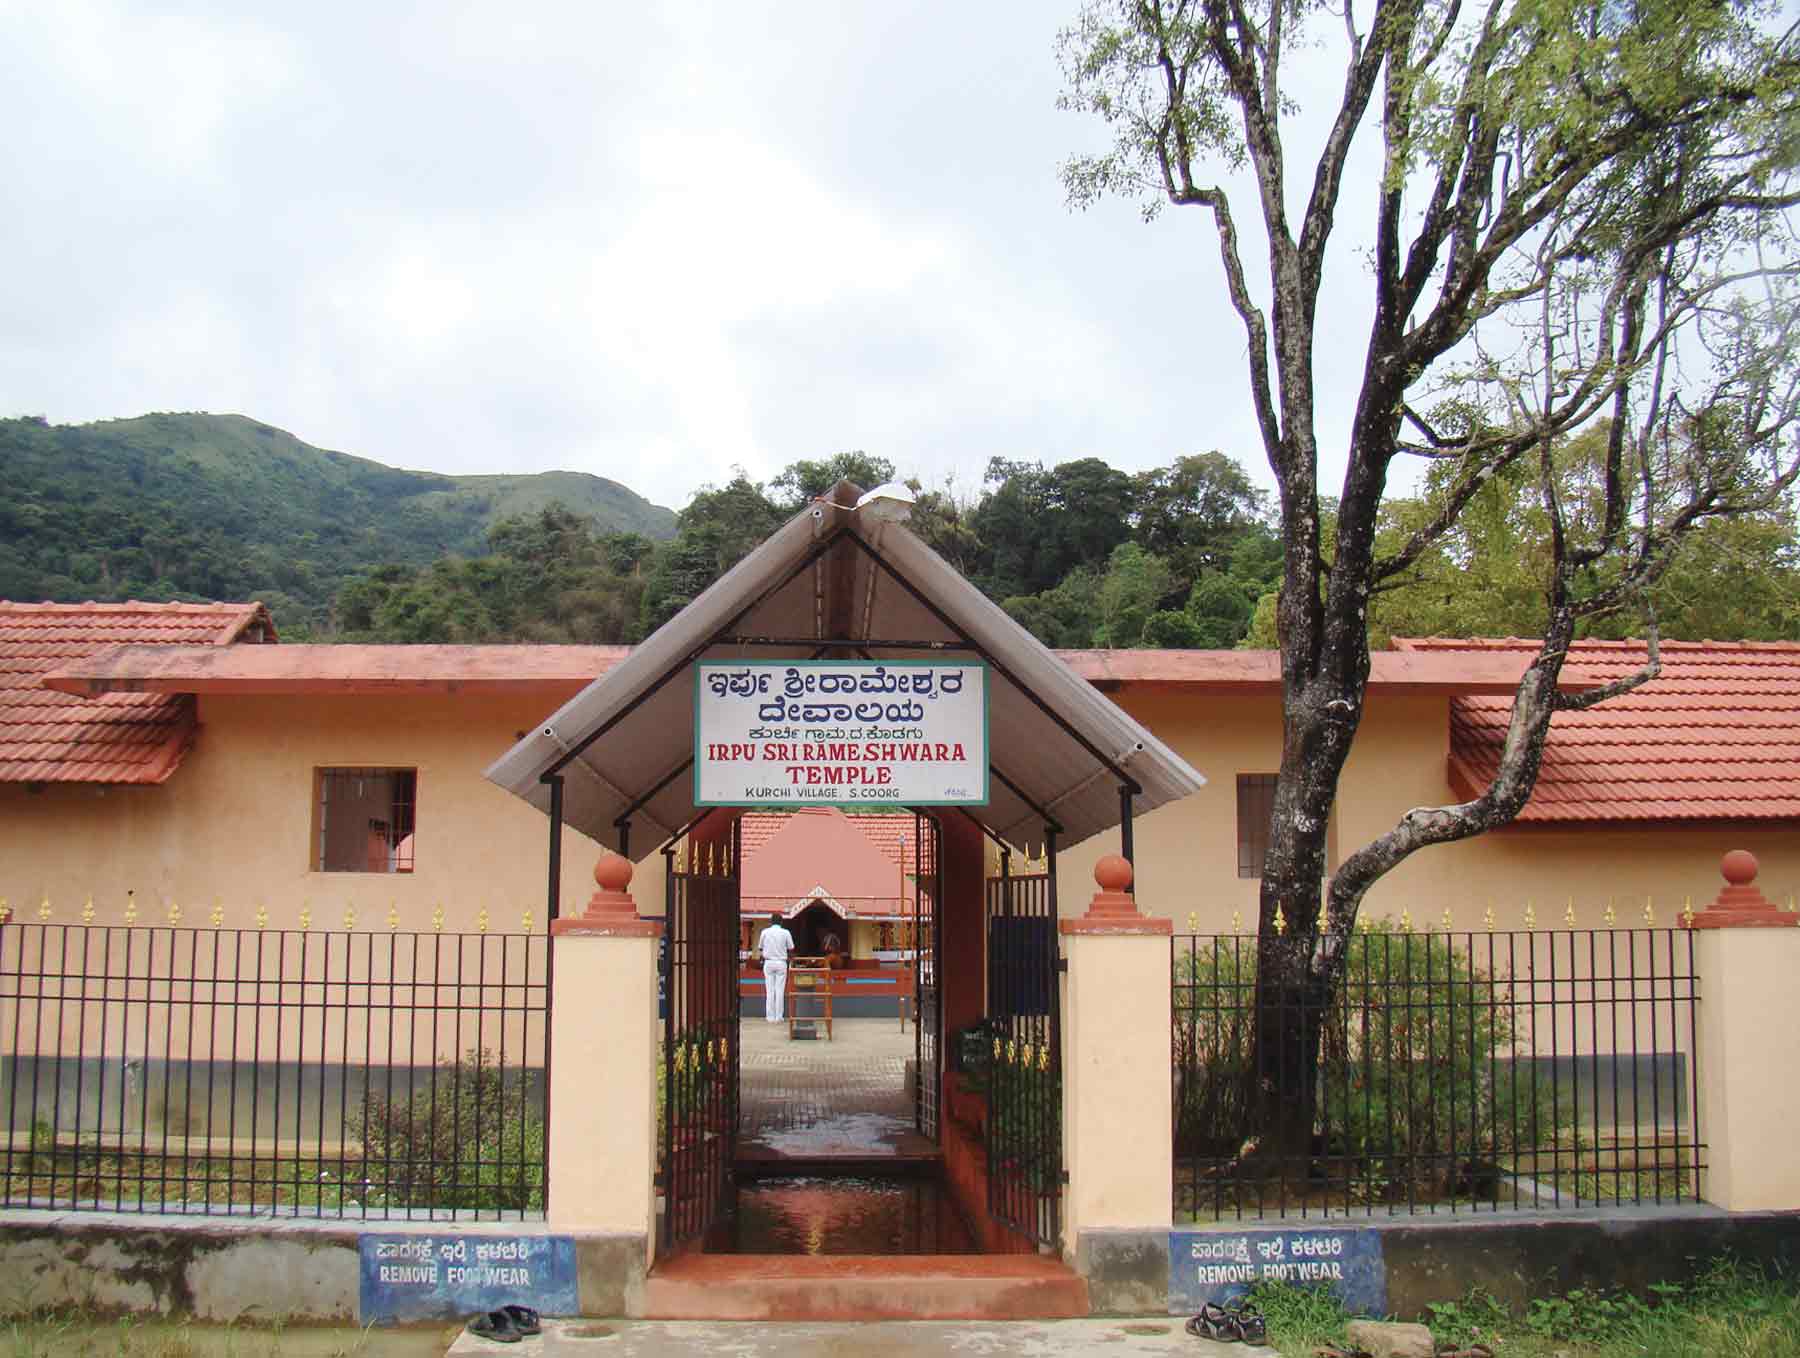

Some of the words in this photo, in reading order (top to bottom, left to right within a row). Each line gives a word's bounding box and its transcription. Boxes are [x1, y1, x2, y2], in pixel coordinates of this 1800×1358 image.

[708, 669, 772, 698] ಇರ್ಪು
[784, 667, 963, 699] ಶ್ರೀರಾಮೇಶ್ವರ
[759, 696, 924, 723] ದೇವಾಲಯ
[708, 743, 756, 761] IRPU
[785, 766, 892, 785] TEMPLE
[745, 787, 791, 798] KURCHI
[379, 1264, 438, 1283] REMOVE
[1198, 1264, 1254, 1284] REMOVE
